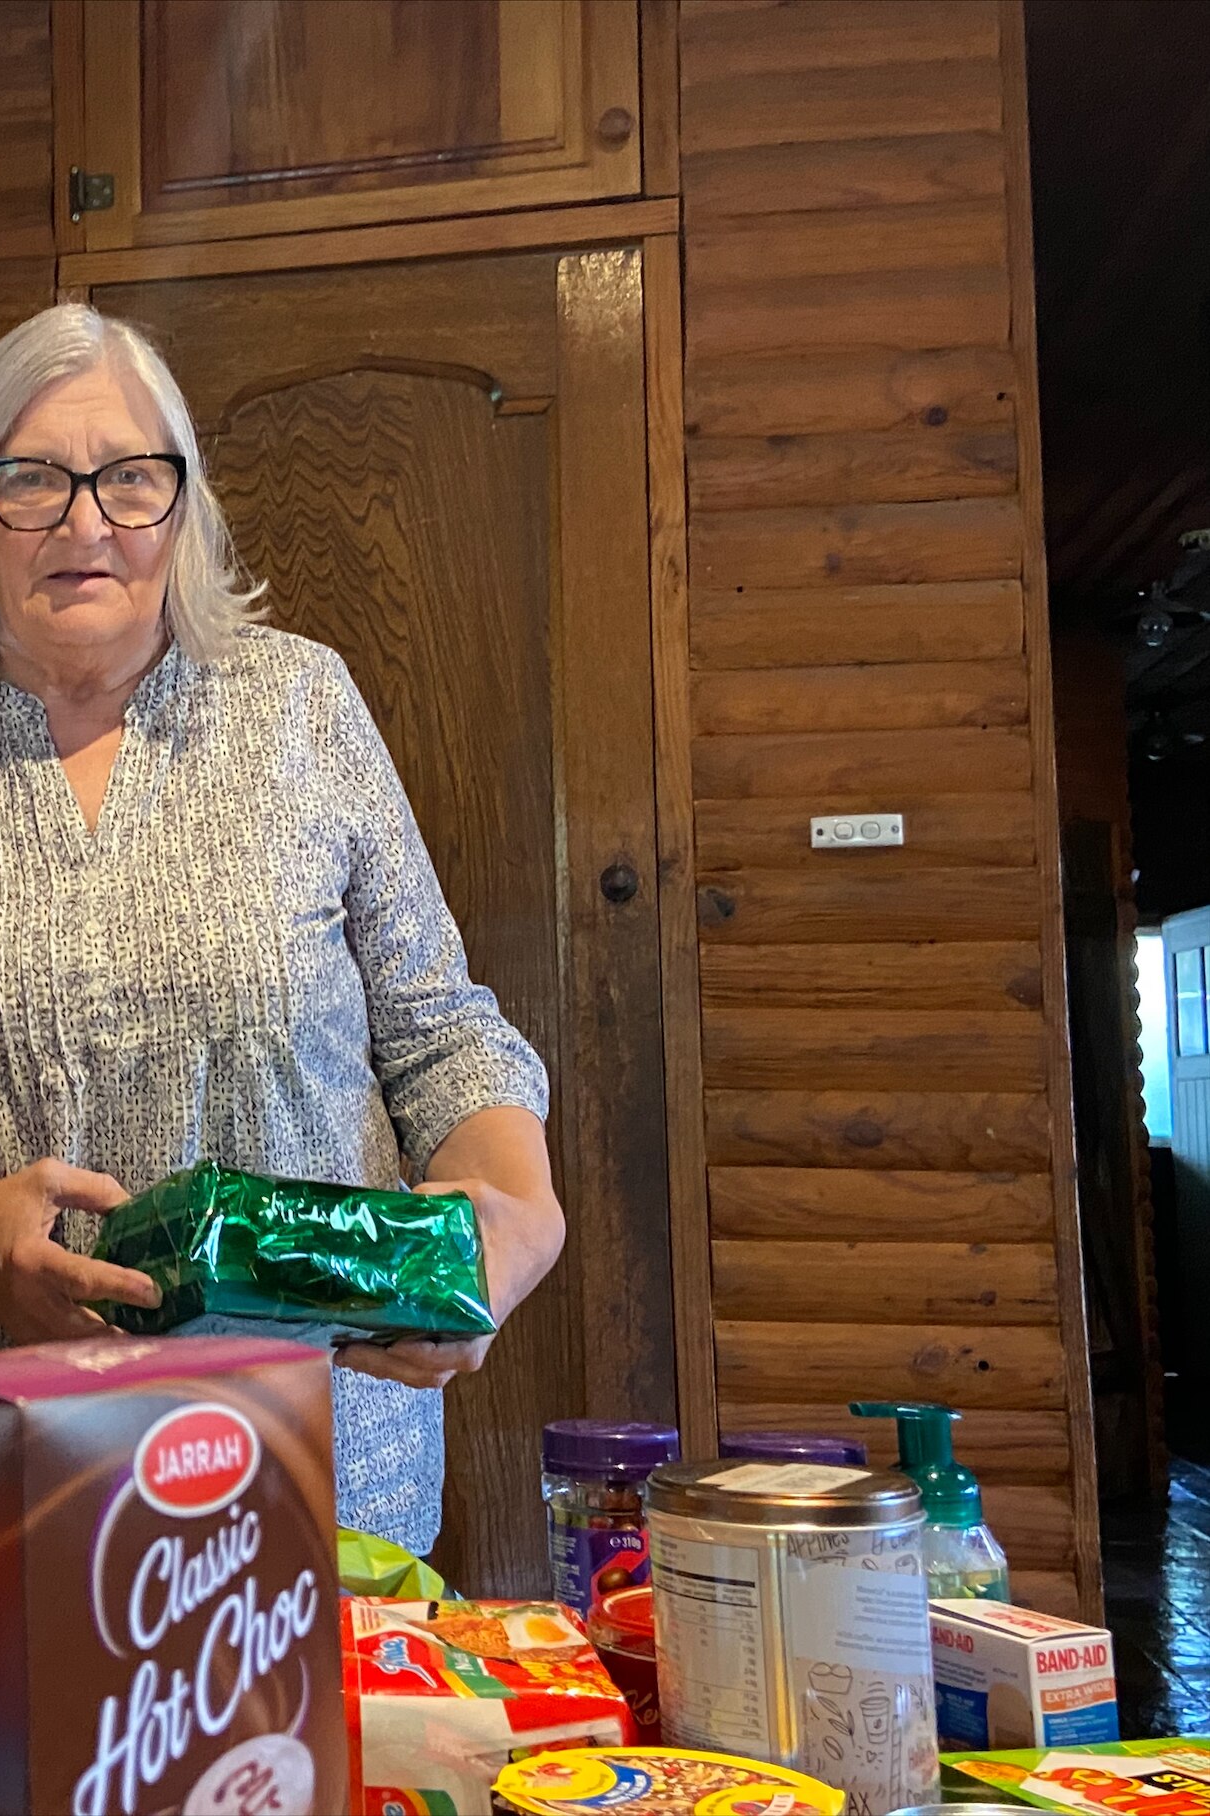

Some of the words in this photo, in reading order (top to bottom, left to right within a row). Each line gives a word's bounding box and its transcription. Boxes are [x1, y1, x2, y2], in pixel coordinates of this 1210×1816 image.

[154, 1434, 242, 1486] JARRAH
[128, 1503, 261, 1651] Classic
[932, 1627, 974, 1654] AND-AID
[1036, 1644, 1108, 1674] BAND-AID
[73, 1659, 194, 1816] Hot
[194, 1570, 320, 1737] Choc
[1045, 1688, 1082, 1704] EXTRA
